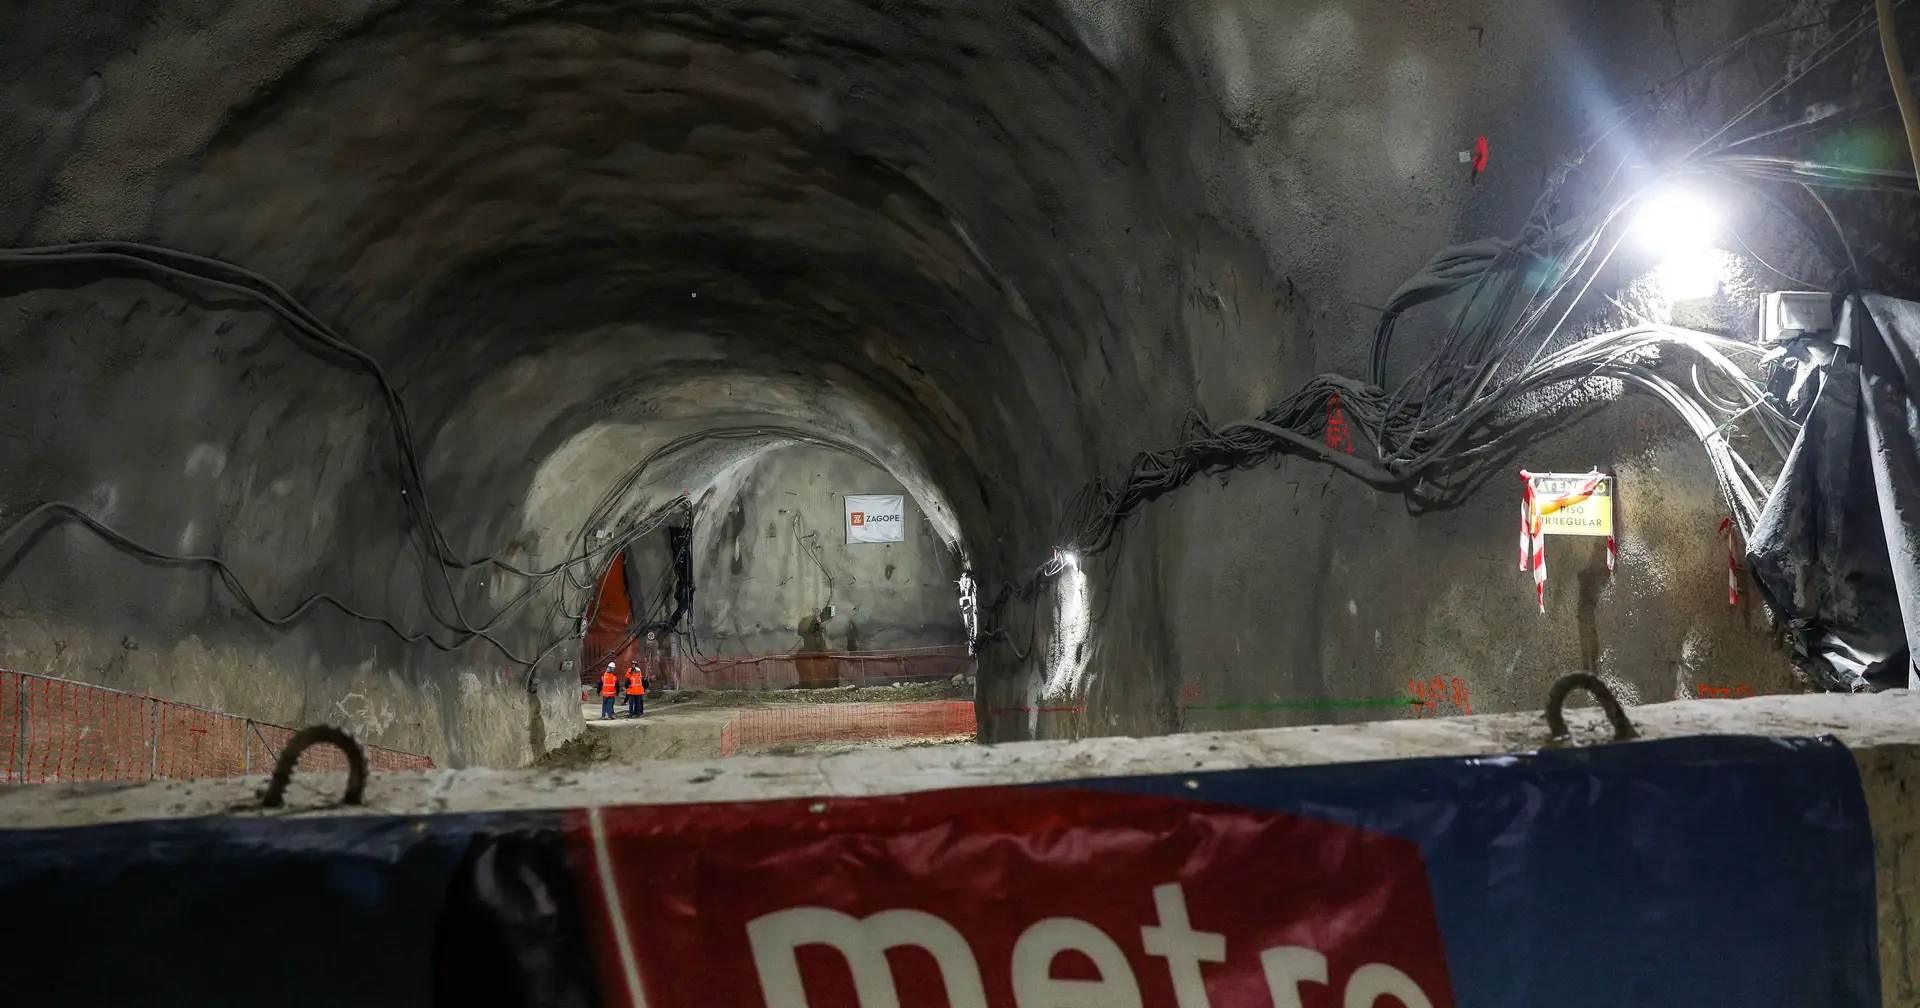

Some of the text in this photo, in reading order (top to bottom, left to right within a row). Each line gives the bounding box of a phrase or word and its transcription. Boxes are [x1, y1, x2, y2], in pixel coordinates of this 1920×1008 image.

[1560, 506, 1585, 514] PISO
[866, 514, 900, 522] ZAGOPE
[1541, 517, 1602, 527] IRREGULAR
